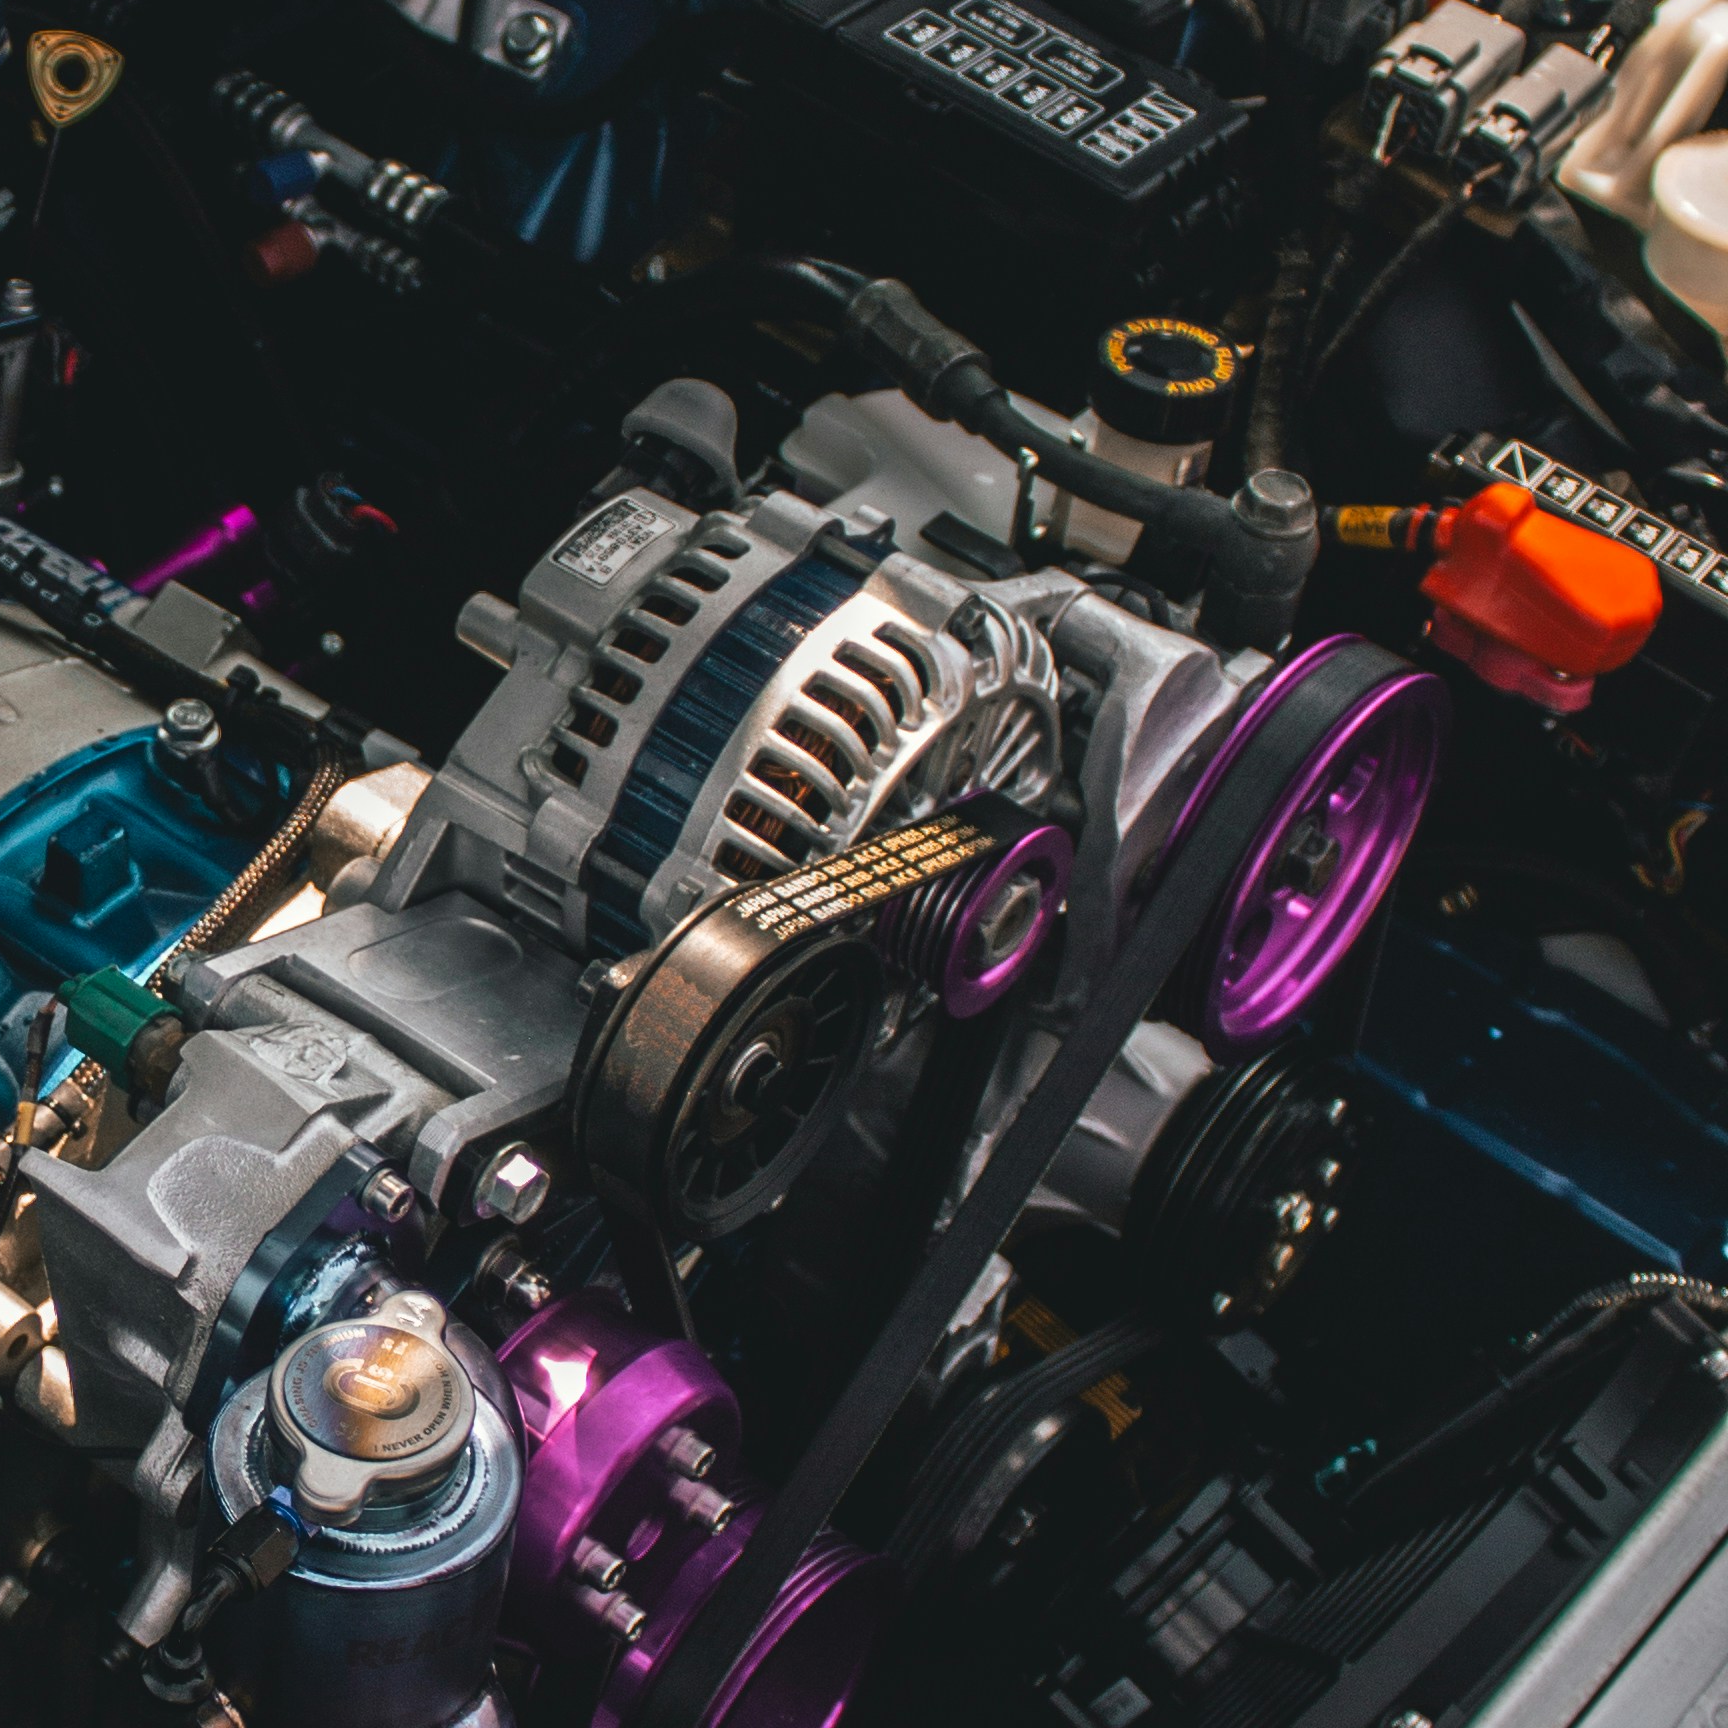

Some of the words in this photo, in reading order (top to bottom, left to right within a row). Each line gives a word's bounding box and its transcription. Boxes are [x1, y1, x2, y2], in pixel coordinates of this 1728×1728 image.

[1124, 318, 1220, 347] STEERING
[736, 890, 779, 919] JAPAN
[773, 870, 829, 900] BANDO
[822, 845, 889, 878] RIB-ACE
[755, 902, 798, 932] JAPAN
[791, 880, 848, 911] BANDO
[841, 855, 906, 890] RIB-ACE
[773, 912, 815, 942] JAPAN
[809, 891, 866, 921] BANDO
[859, 866, 923, 900] RIB-ACE
[381, 1433, 423, 1453] NEVER
[423, 1410, 446, 1437] OPEN
[440, 1379, 454, 1412] WHEN
